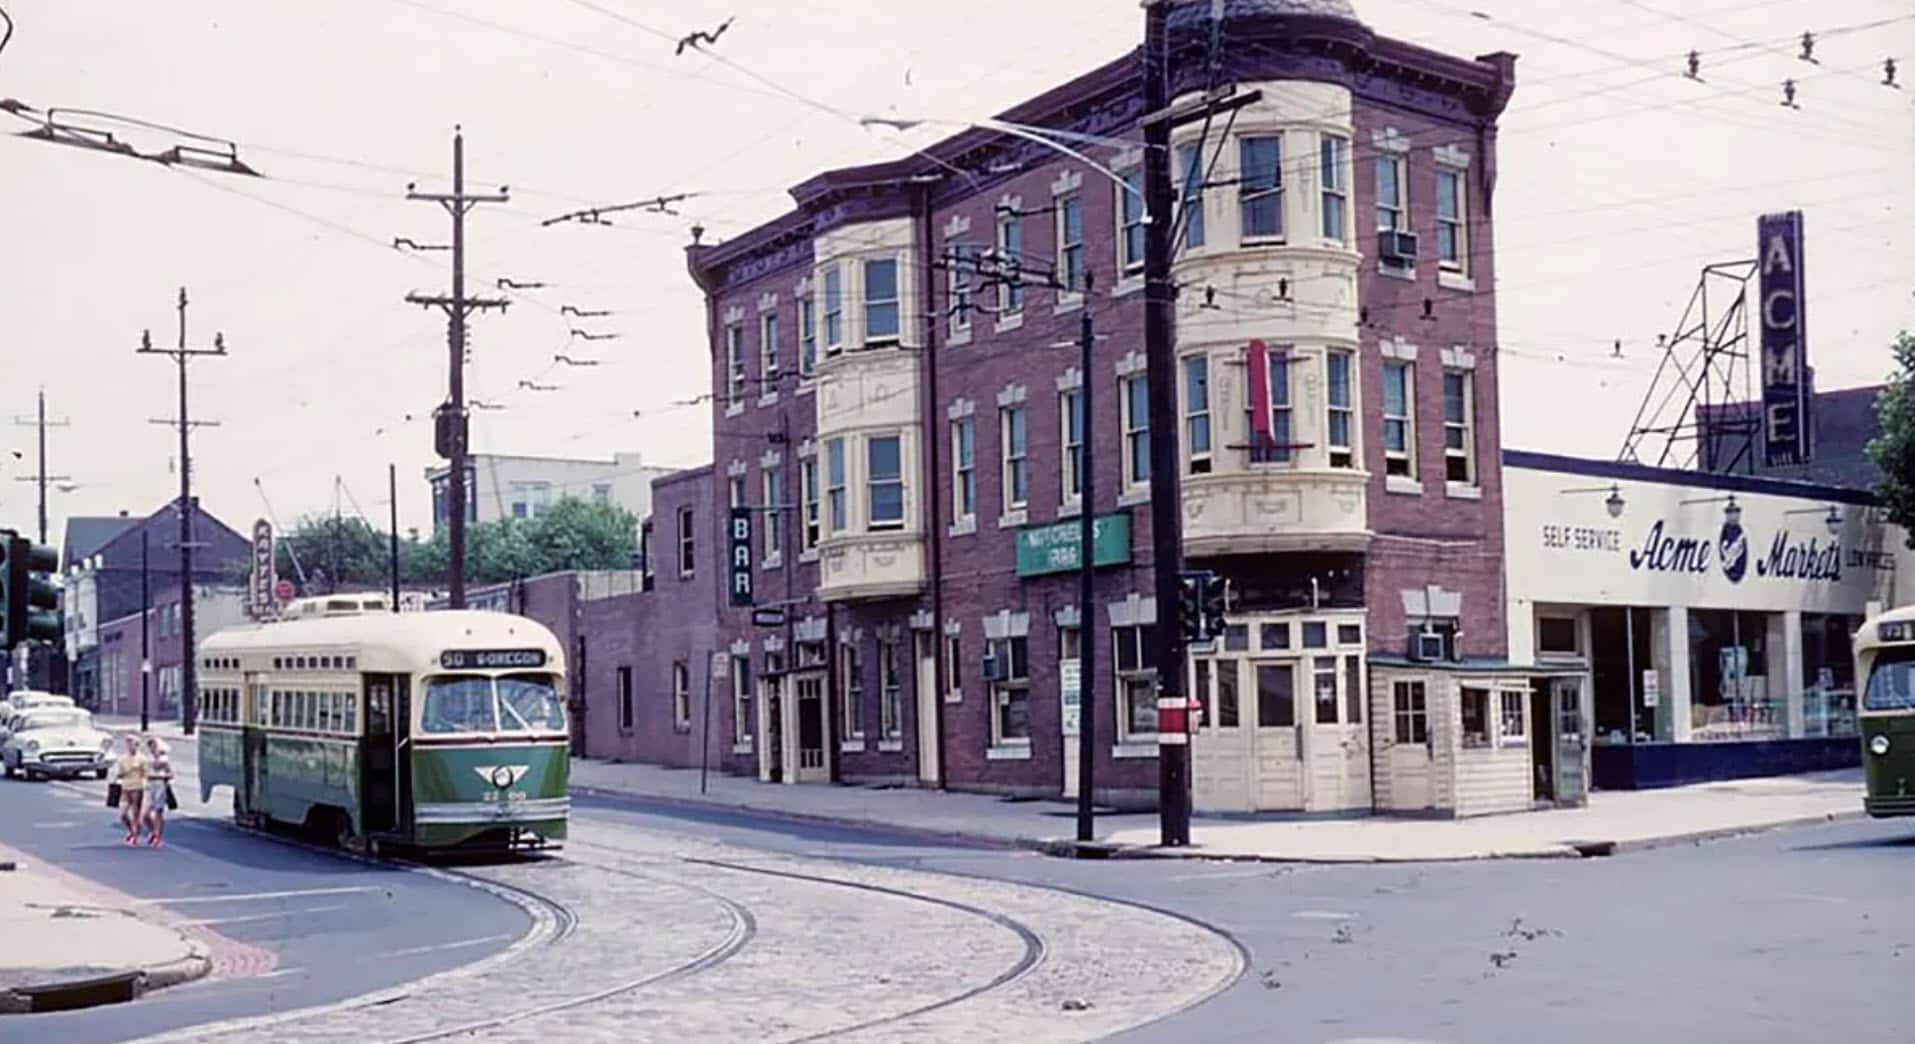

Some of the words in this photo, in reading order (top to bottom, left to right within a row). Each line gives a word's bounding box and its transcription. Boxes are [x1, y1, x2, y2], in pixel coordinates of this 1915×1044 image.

[1762, 234, 1796, 443] ACME
[734, 518, 749, 594] BAR
[1543, 525, 1570, 548] SELF
[1575, 527, 1620, 551] SERVICE
[1630, 519, 1712, 573] Acme
[1757, 528, 1841, 582] Markets
